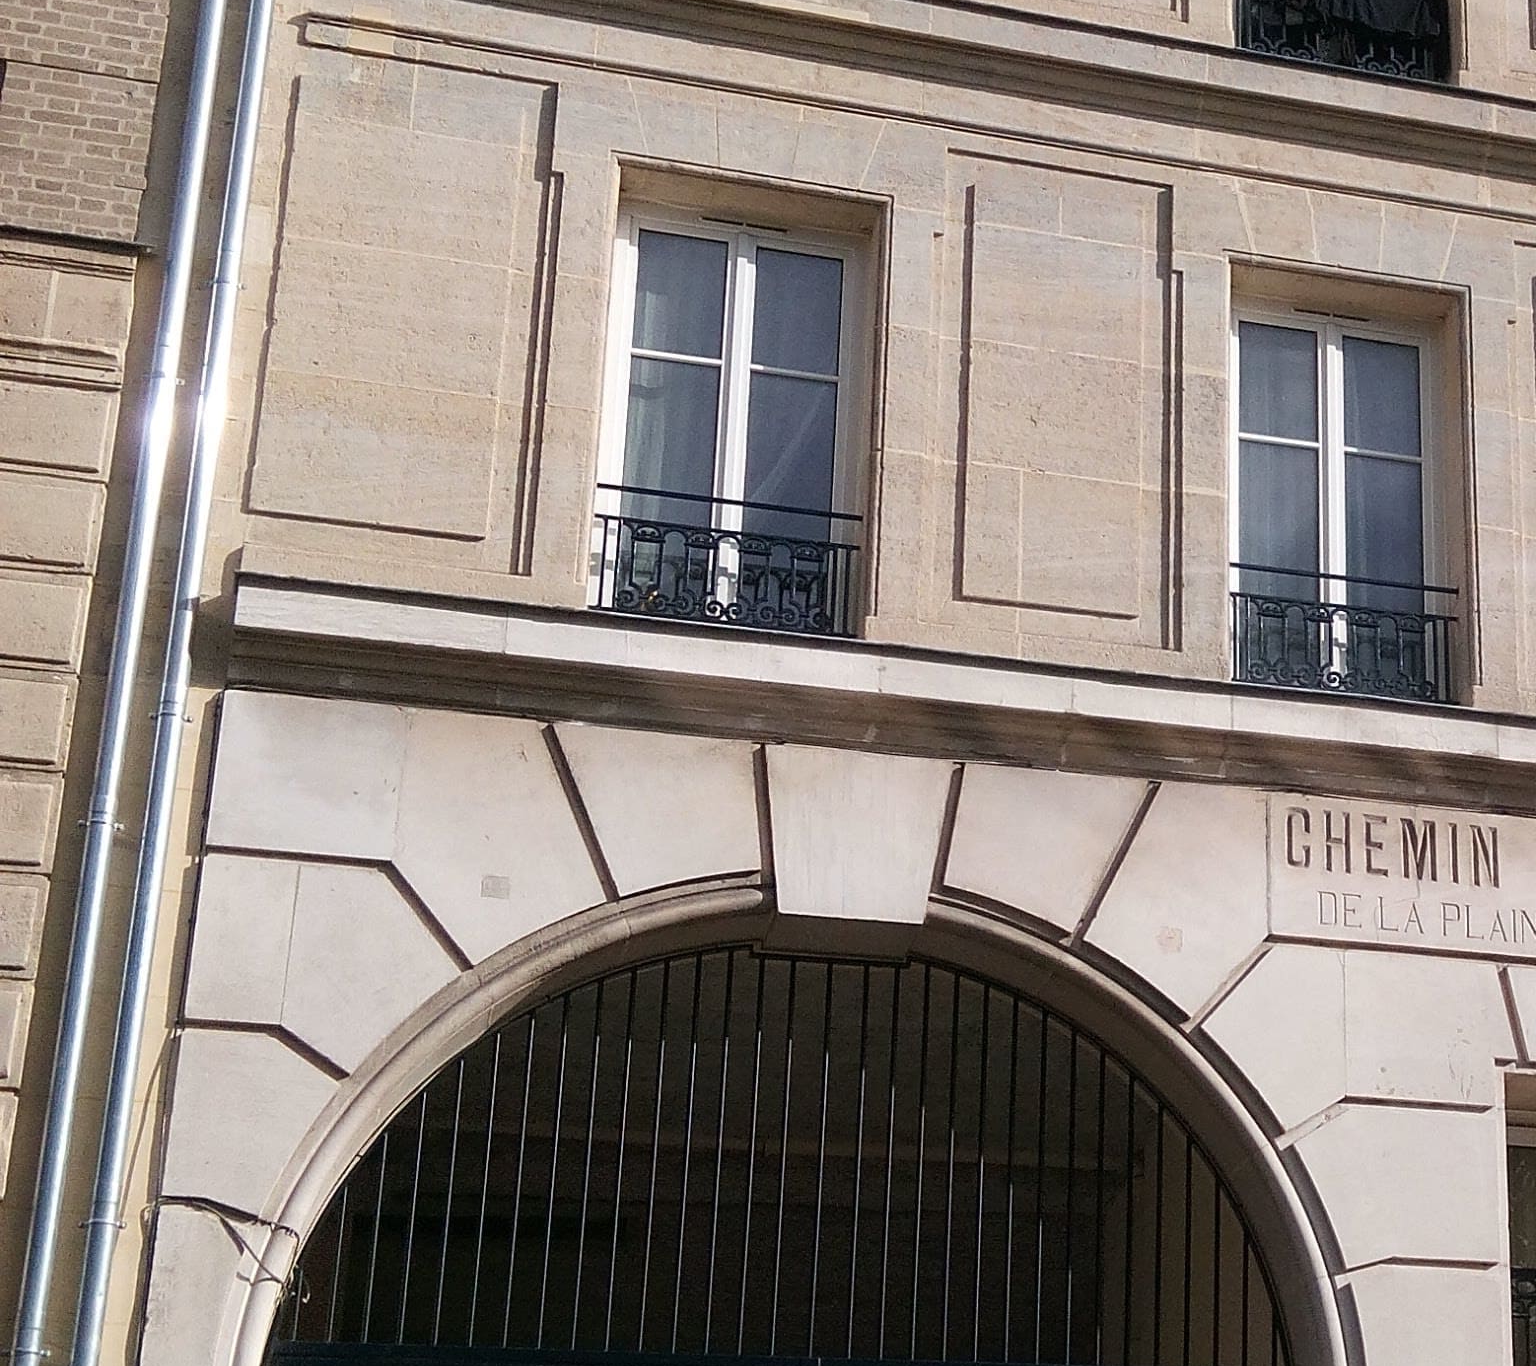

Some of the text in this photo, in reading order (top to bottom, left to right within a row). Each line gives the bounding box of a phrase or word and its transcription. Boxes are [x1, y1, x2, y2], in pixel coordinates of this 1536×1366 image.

[1285, 806, 1501, 889] CHEMIN
[1316, 890, 1363, 929] DE
[1377, 896, 1425, 935] LA
